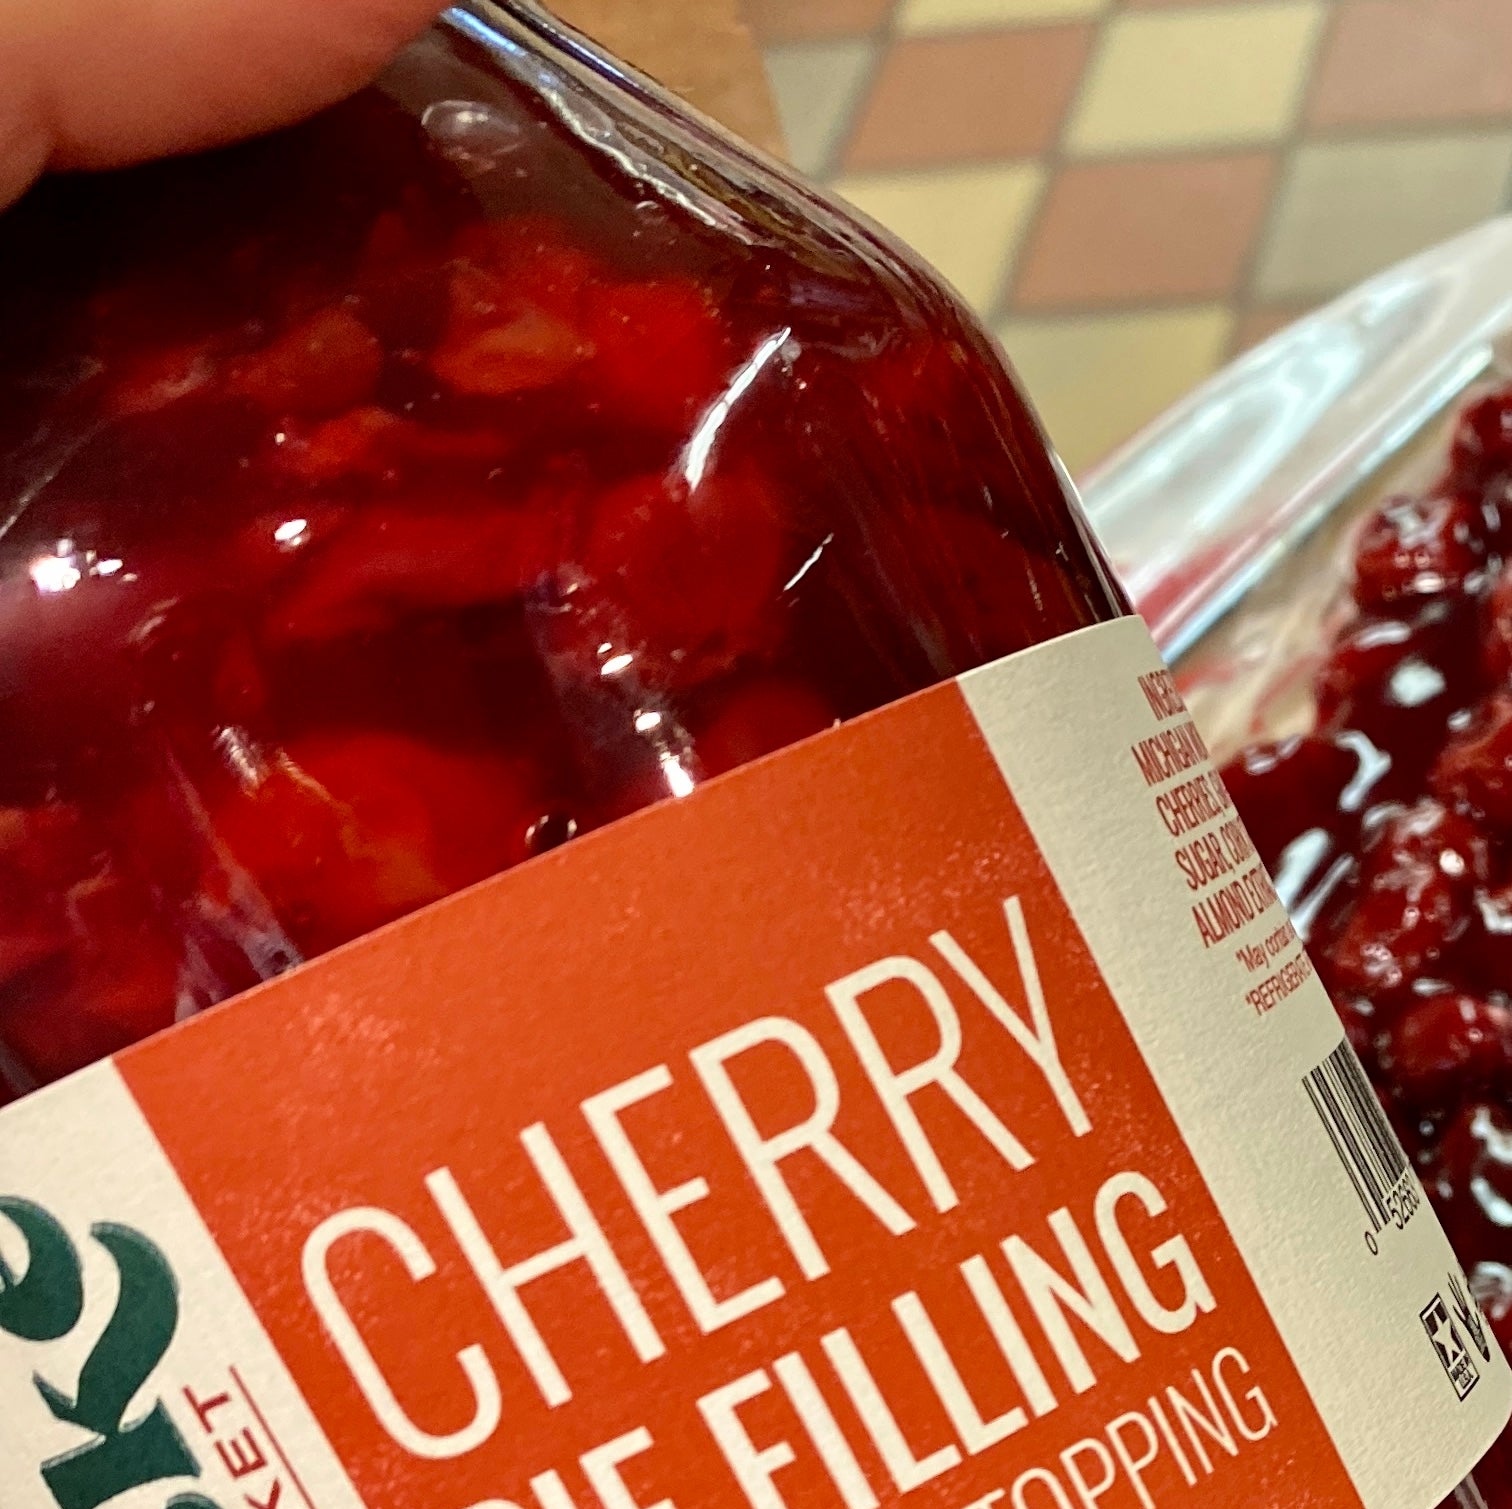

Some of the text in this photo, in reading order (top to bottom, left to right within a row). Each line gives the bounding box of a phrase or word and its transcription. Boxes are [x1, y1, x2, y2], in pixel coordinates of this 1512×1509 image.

[1175, 832, 1236, 890] SUGAR,
[1188, 879, 1255, 949] ALMOND
[301, 895, 1093, 1459] CHERRY
[1364, 1230, 1379, 1256] 0
